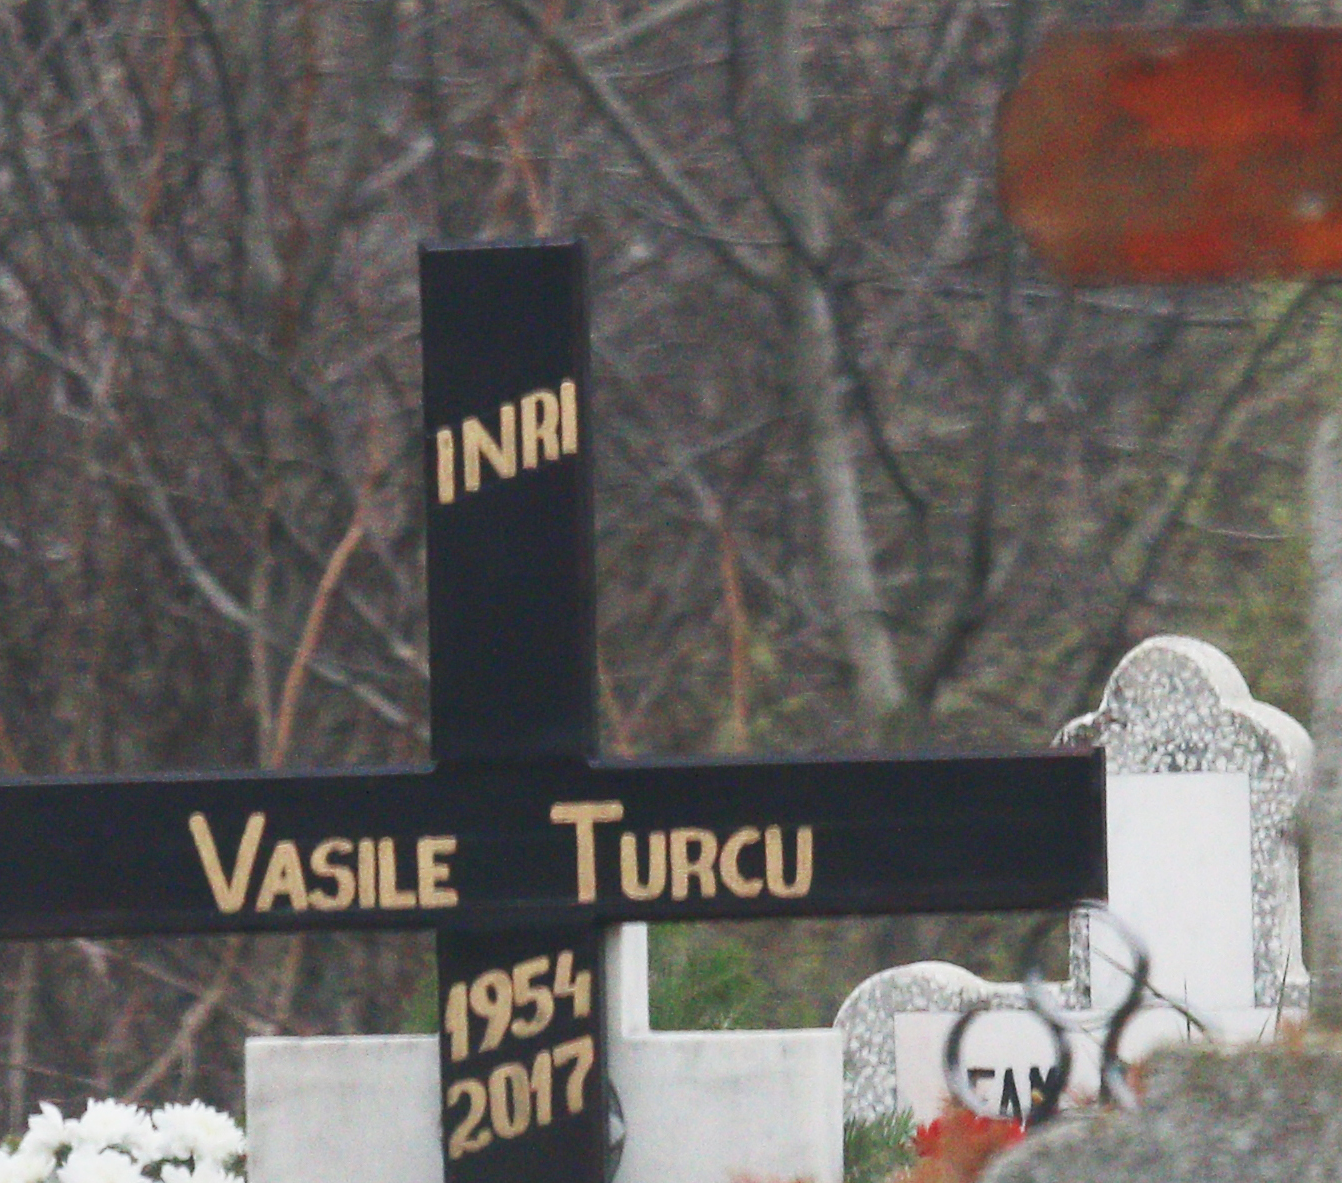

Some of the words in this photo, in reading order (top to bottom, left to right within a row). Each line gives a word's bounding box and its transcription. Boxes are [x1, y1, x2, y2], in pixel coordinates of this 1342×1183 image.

[436, 376, 577, 505] INRI
[445, 949, 592, 1064] 1954
[447, 1034, 594, 1160] 2017
